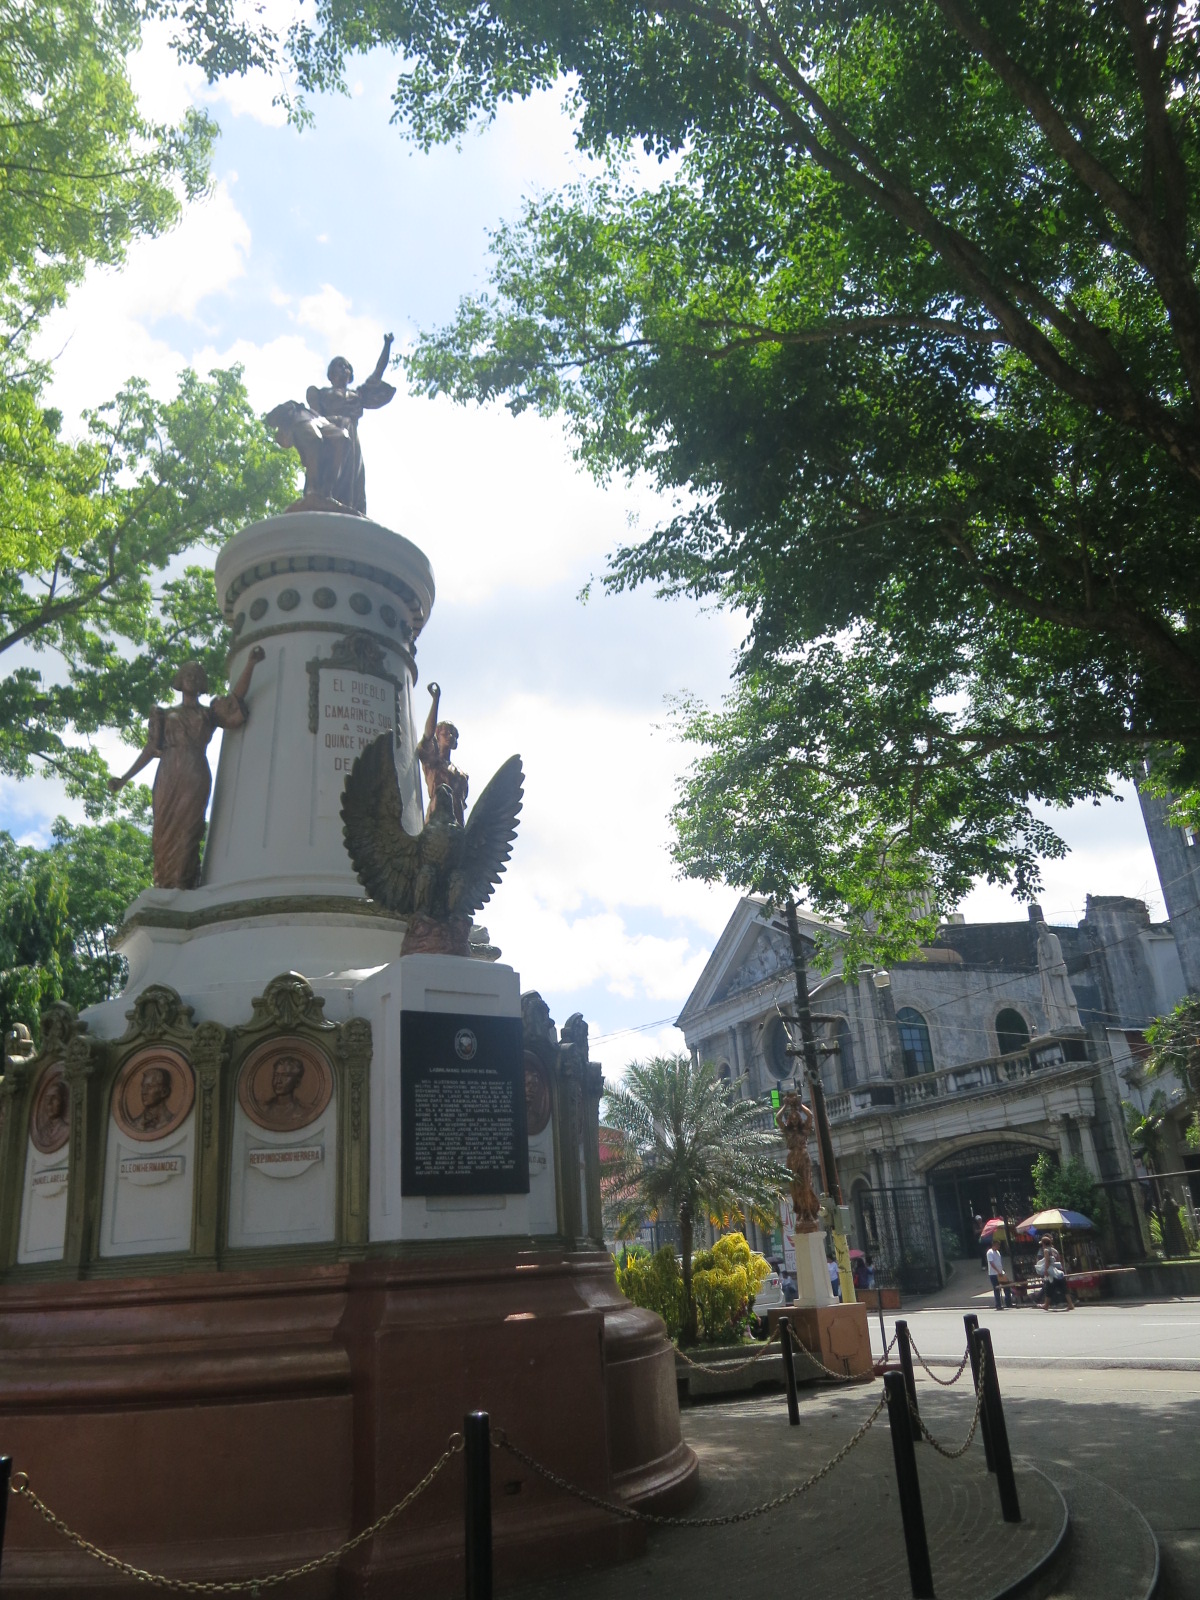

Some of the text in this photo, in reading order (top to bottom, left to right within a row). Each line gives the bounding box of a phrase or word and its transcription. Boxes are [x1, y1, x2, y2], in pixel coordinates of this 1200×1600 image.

[333, 678, 386, 702] EL PUEBLO
[351, 697, 371, 707] DE
[325, 704, 392, 730] CAMARINES SUR
[343, 723, 379, 737] A SUS
[325, 733, 355, 749] QUINCE
[293, 1150, 320, 1162] HERRERA
[141, 1161, 178, 1173] HERNANDEZ
